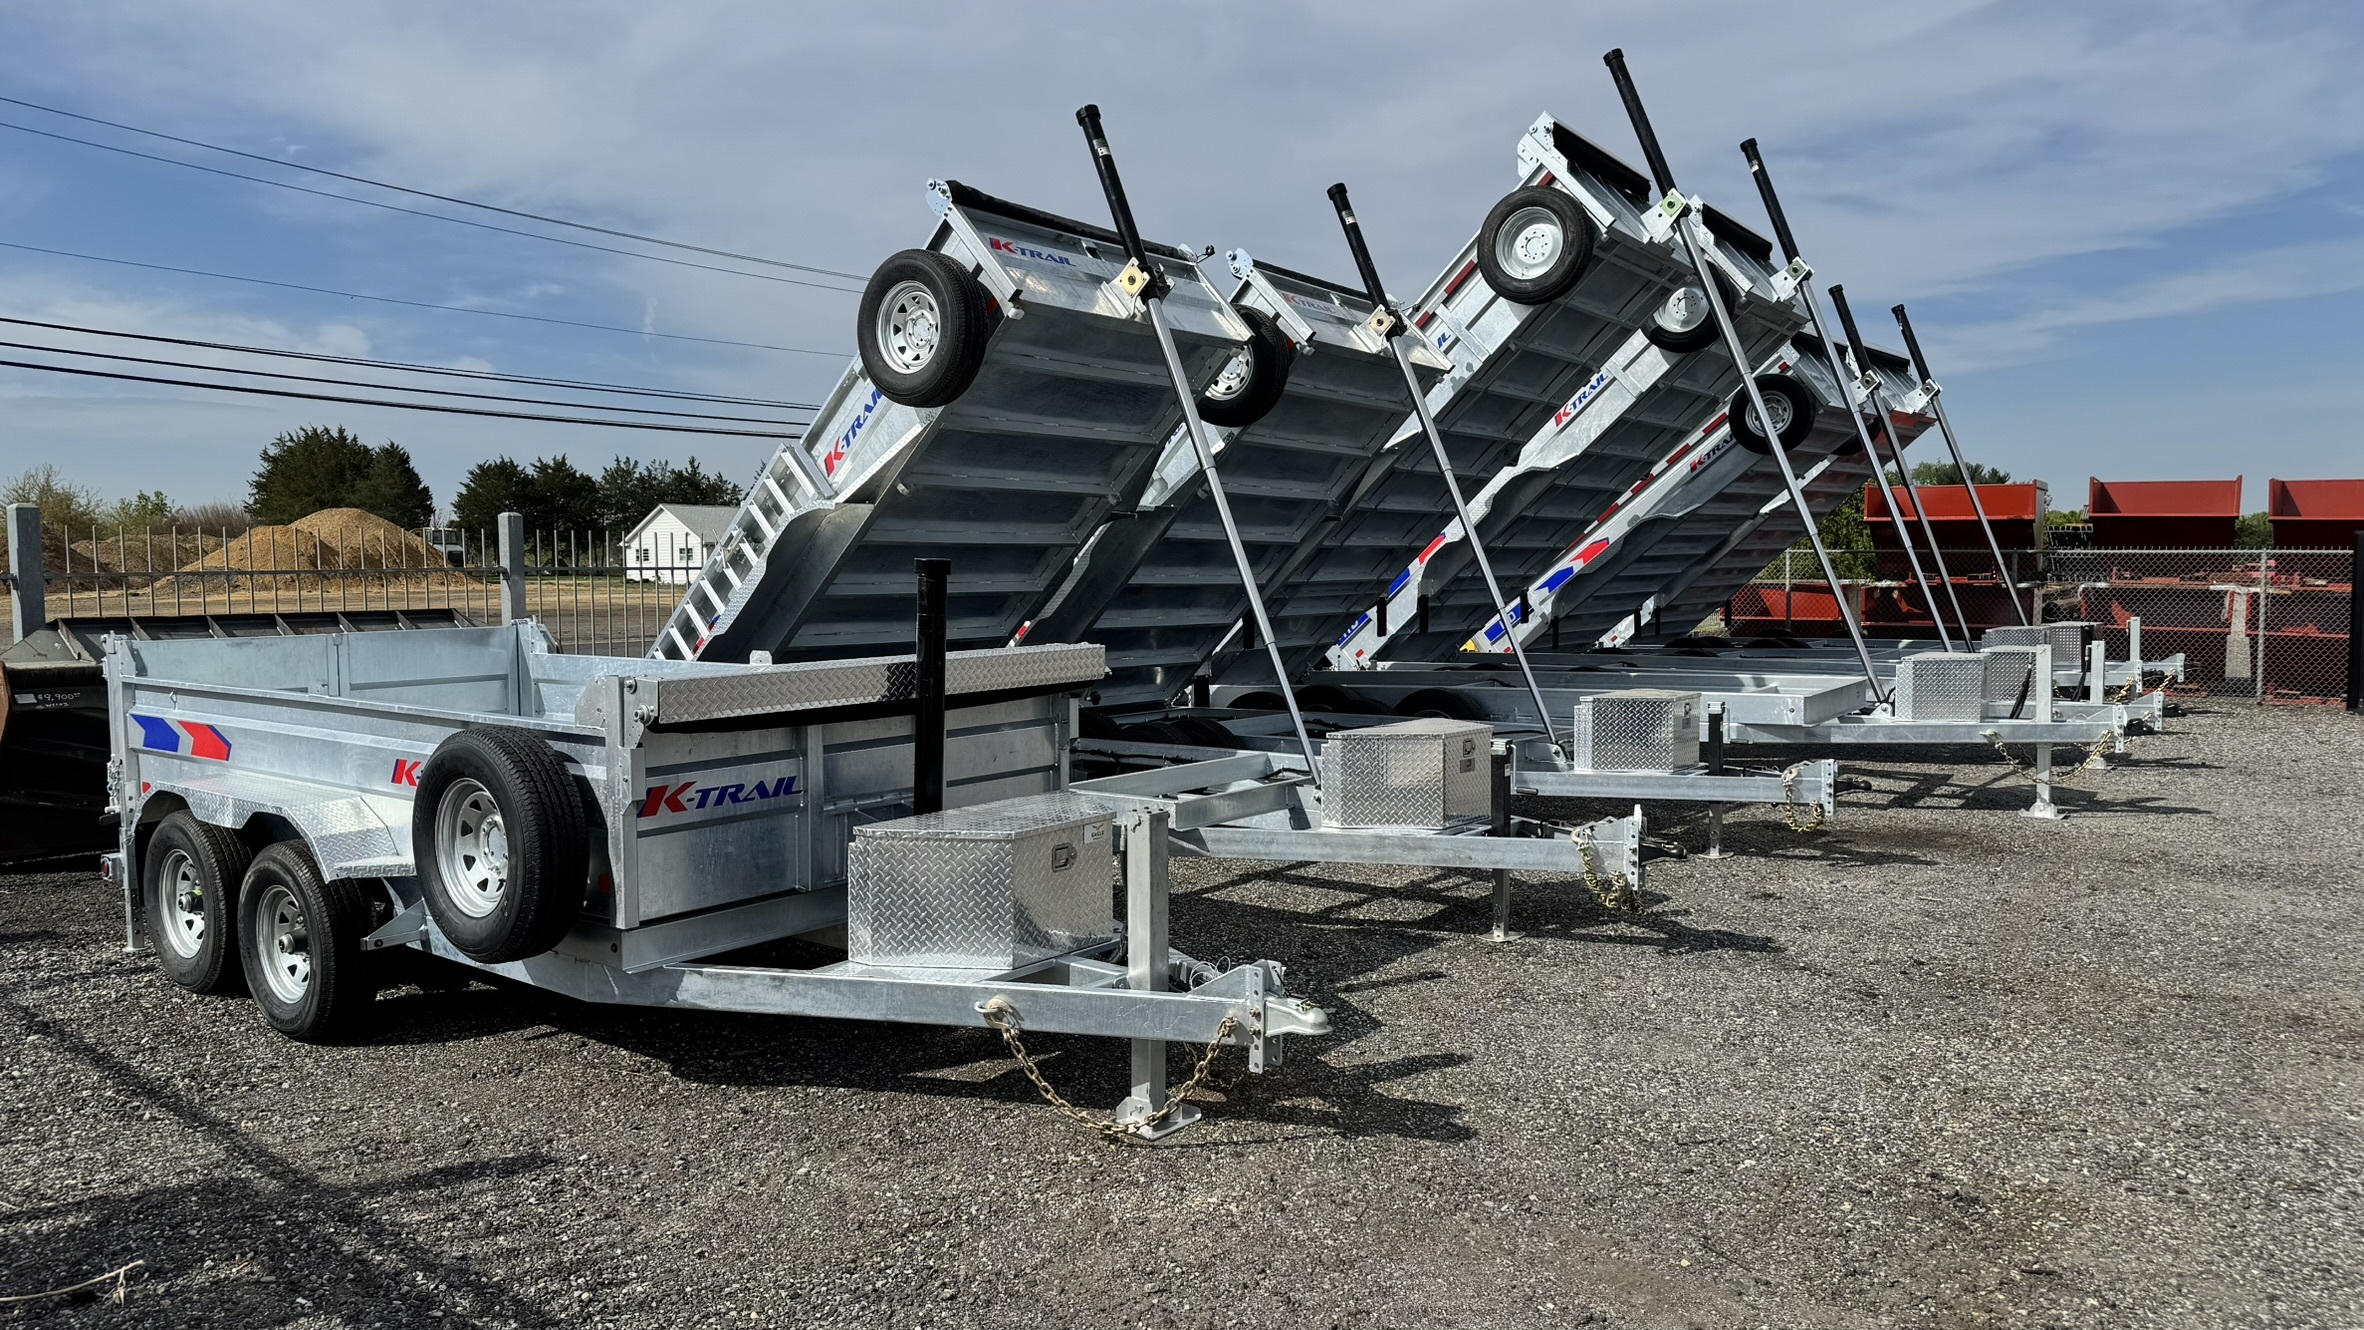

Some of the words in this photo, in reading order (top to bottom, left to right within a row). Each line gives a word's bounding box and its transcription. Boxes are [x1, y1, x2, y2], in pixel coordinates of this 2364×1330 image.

[989, 237, 1077, 266] K-TRAIL
[1554, 373, 1608, 427] K-TRAIL
[1690, 434, 1734, 473] K-TRAI
[636, 775, 805, 818] K-TRAIL
